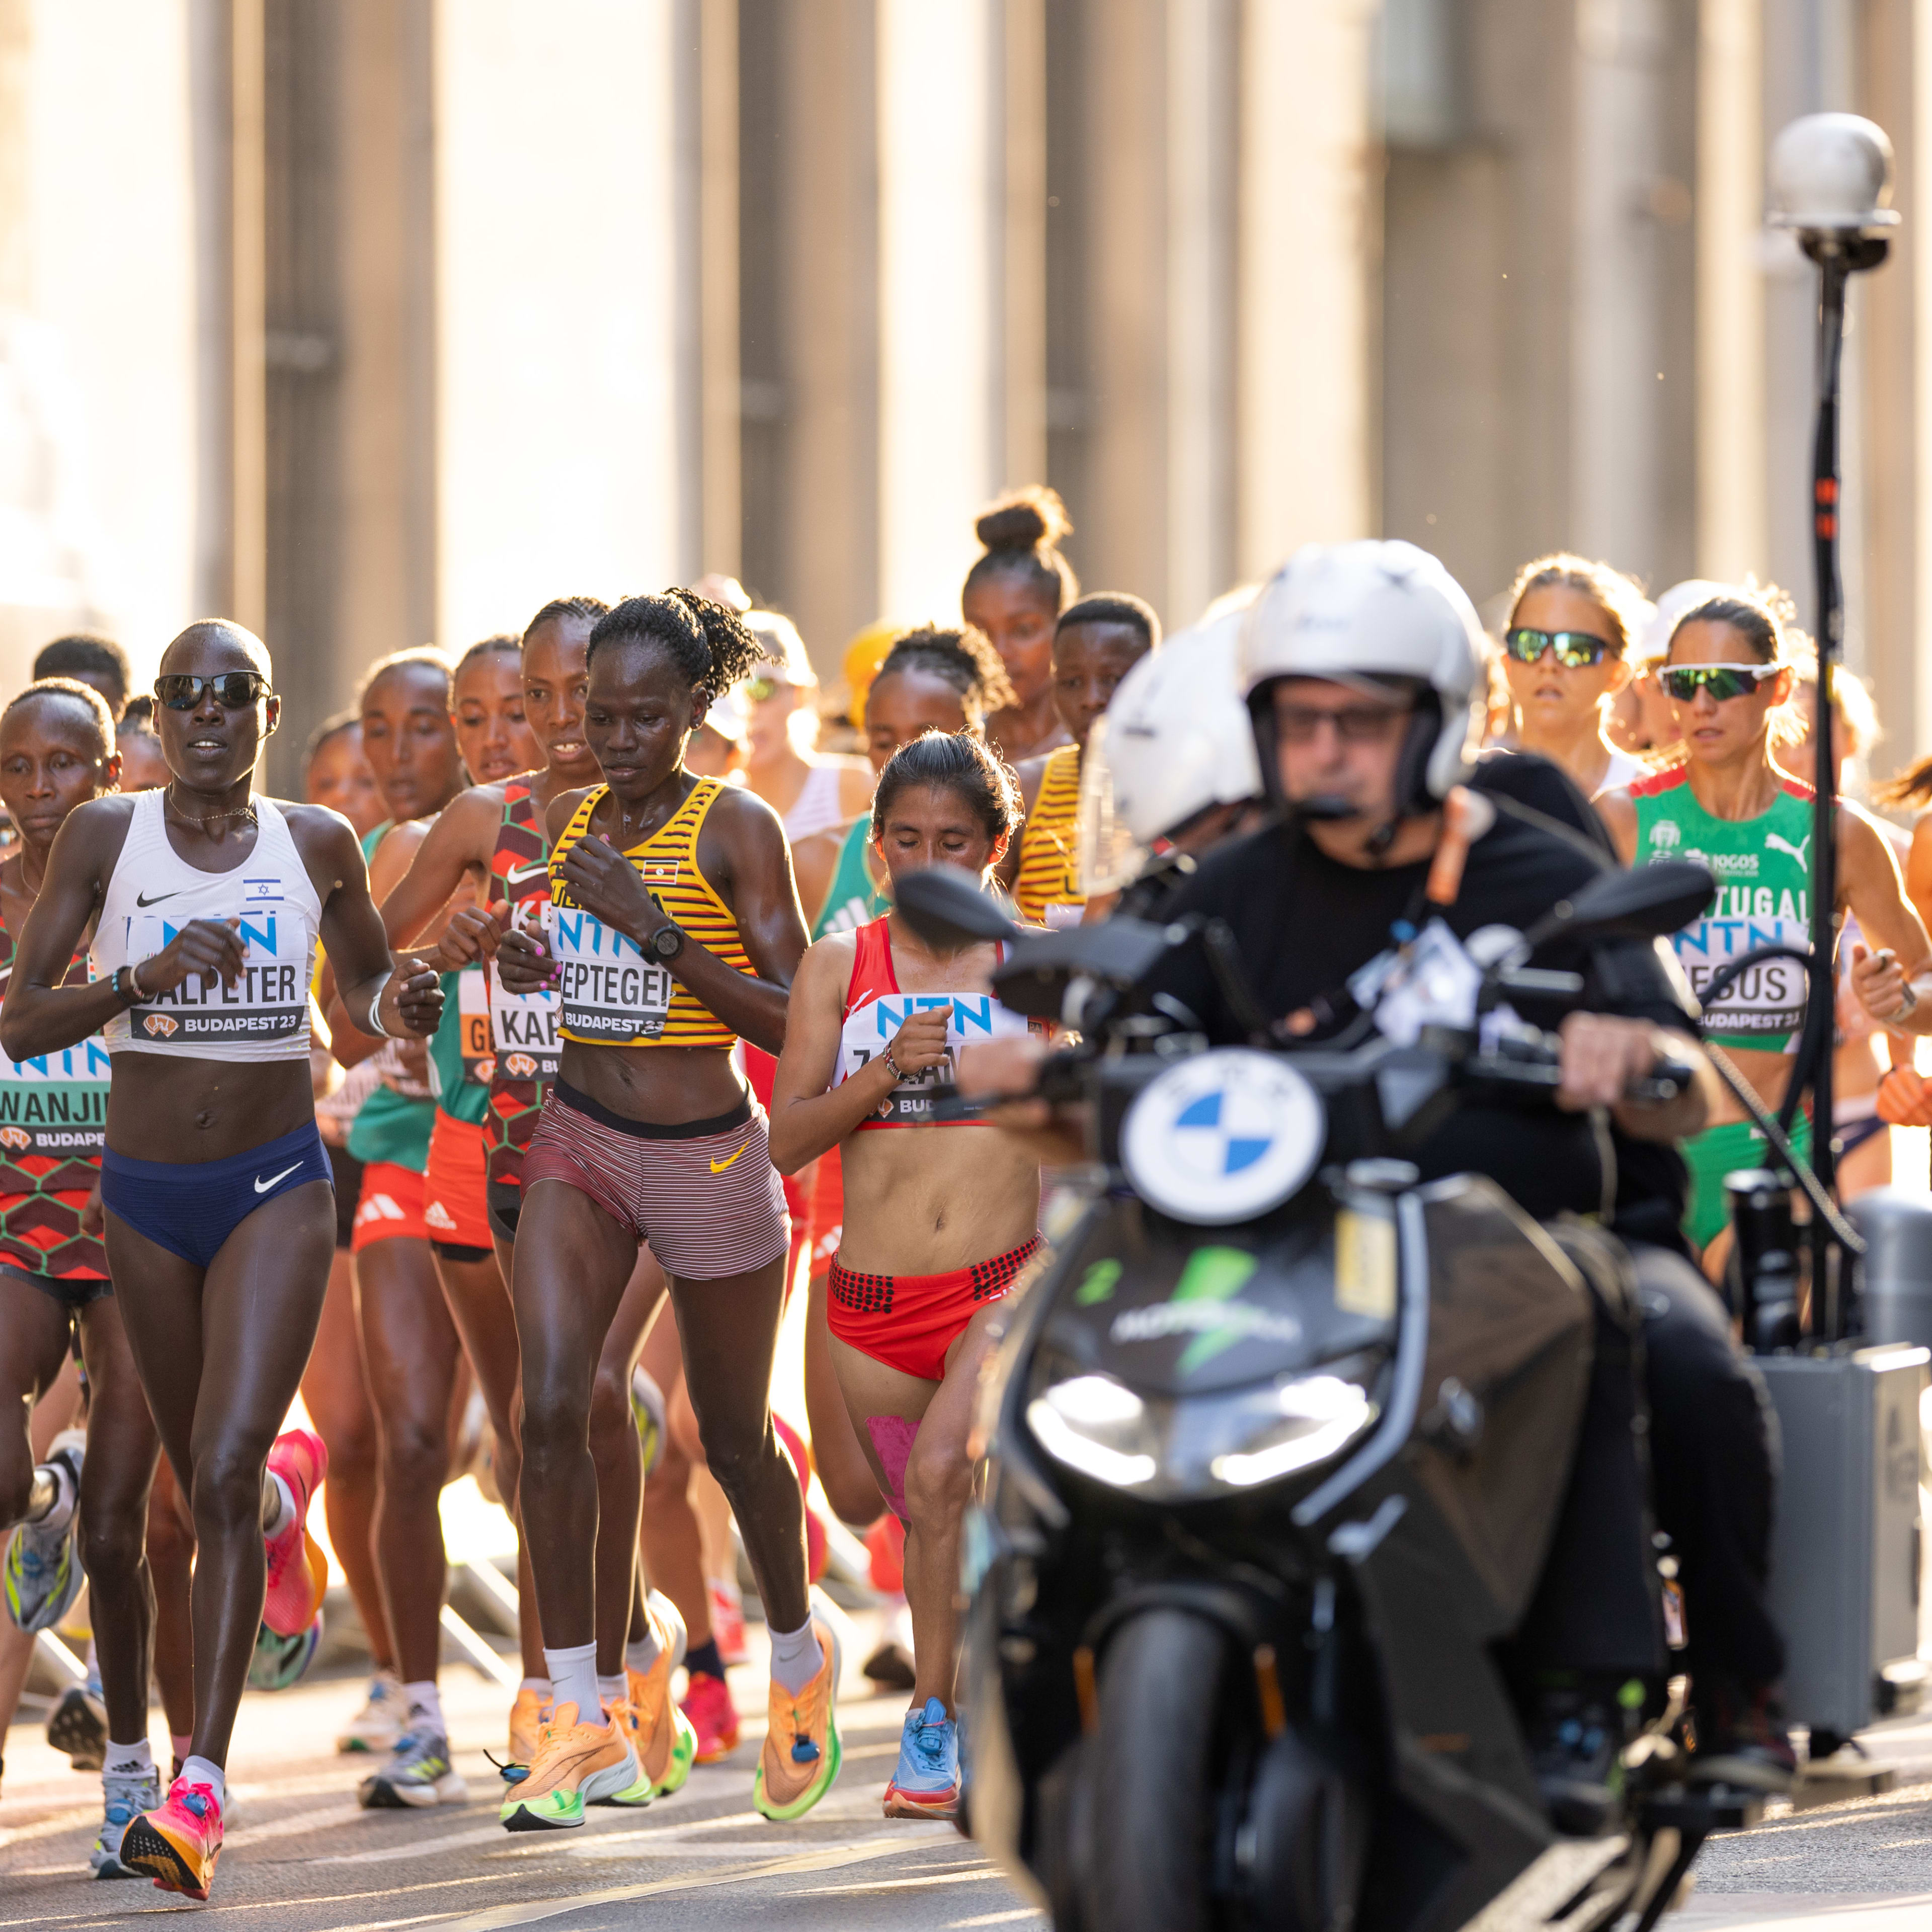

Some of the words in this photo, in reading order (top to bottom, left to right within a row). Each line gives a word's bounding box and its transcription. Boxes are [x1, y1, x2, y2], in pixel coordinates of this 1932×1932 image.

[1712, 854, 1759, 871] JOGOS
[1700, 886, 1811, 925] TUGAL
[144, 964, 296, 1005] ALPETER
[560, 960, 668, 1007] EPTEGEI
[1682, 964, 1787, 1001] ESUS
[185, 1015, 278, 1032] BUDAPEST
[279, 1014, 297, 1028] 23
[565, 1012, 643, 1032] BUDAPEST
[0, 1091, 111, 1122] WANJI
